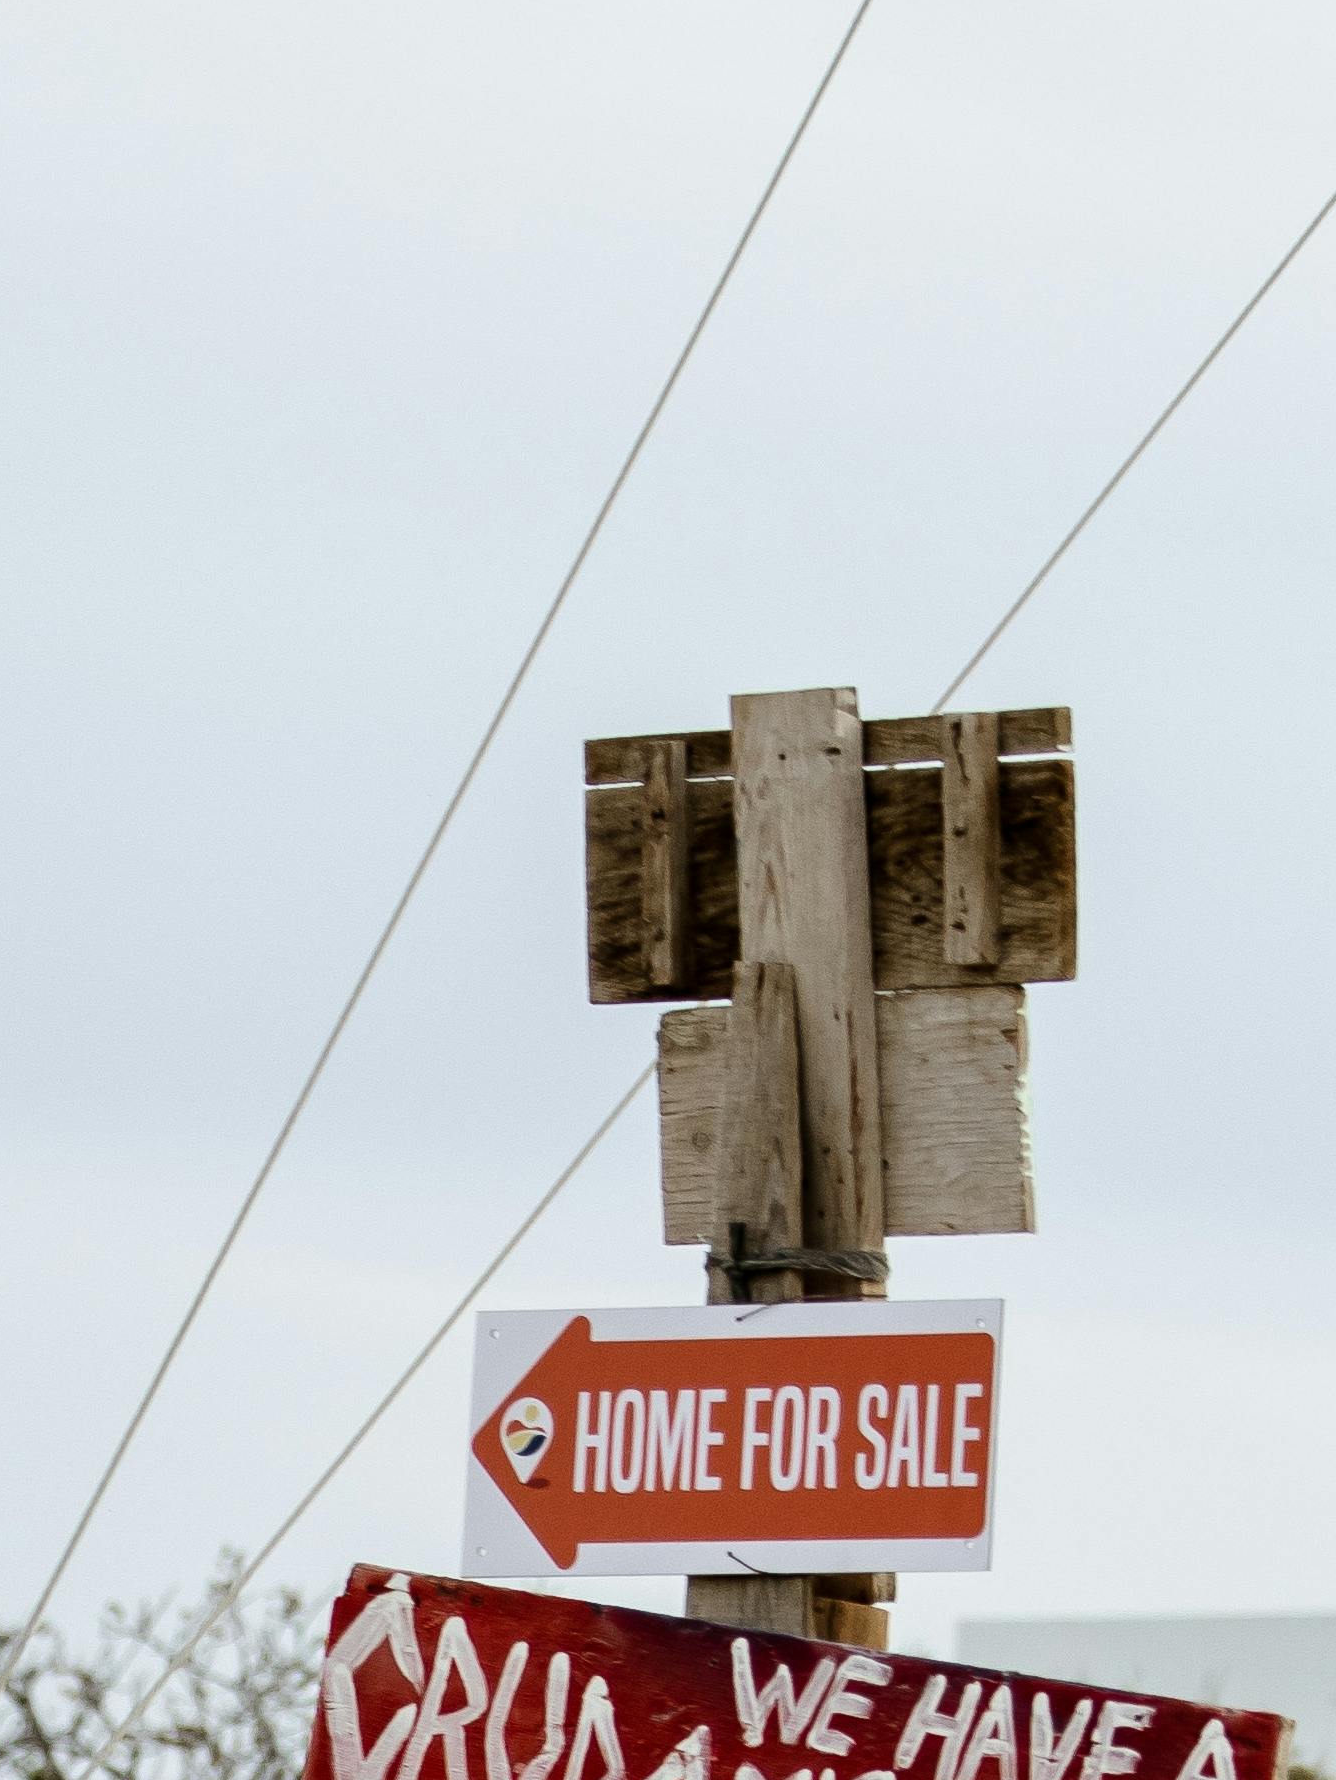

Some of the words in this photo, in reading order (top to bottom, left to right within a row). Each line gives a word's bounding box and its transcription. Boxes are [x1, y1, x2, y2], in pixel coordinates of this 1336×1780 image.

[572, 1387, 728, 1493] HOME
[739, 1384, 842, 1491] FOR
[854, 1382, 984, 1490] SALE
[731, 1637, 893, 1757] WE
